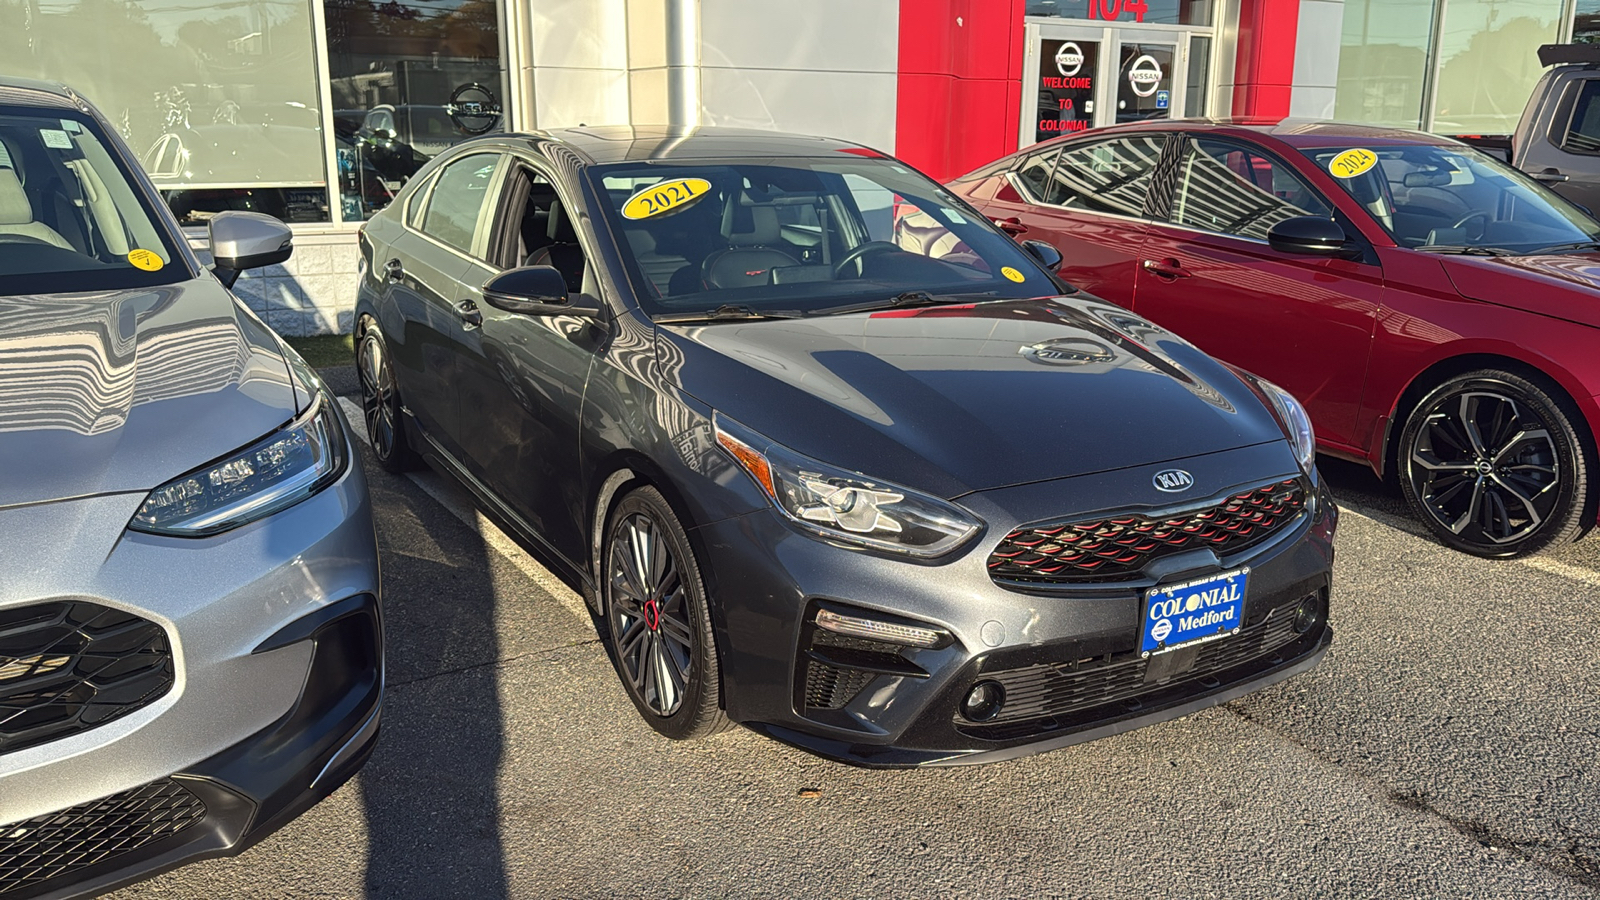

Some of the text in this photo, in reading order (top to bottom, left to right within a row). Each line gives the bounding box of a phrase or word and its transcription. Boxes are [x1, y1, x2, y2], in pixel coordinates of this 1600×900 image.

[1058, 56, 1082, 64] NISSAN
[1042, 77, 1091, 89] WELCOME
[1132, 73, 1160, 81] NISSAN
[1059, 98, 1073, 110] TO
[1337, 150, 1371, 174] 2024
[640, 181, 697, 215] 2021
[1157, 471, 1191, 488] KIA
[1161, 583, 1188, 593] COLONIAL
[1189, 578, 1208, 587] NISSAN
[1217, 571, 1241, 580] MEDFORD
[1150, 584, 1241, 620] COLONIAL
[1177, 605, 1235, 633] Medford
